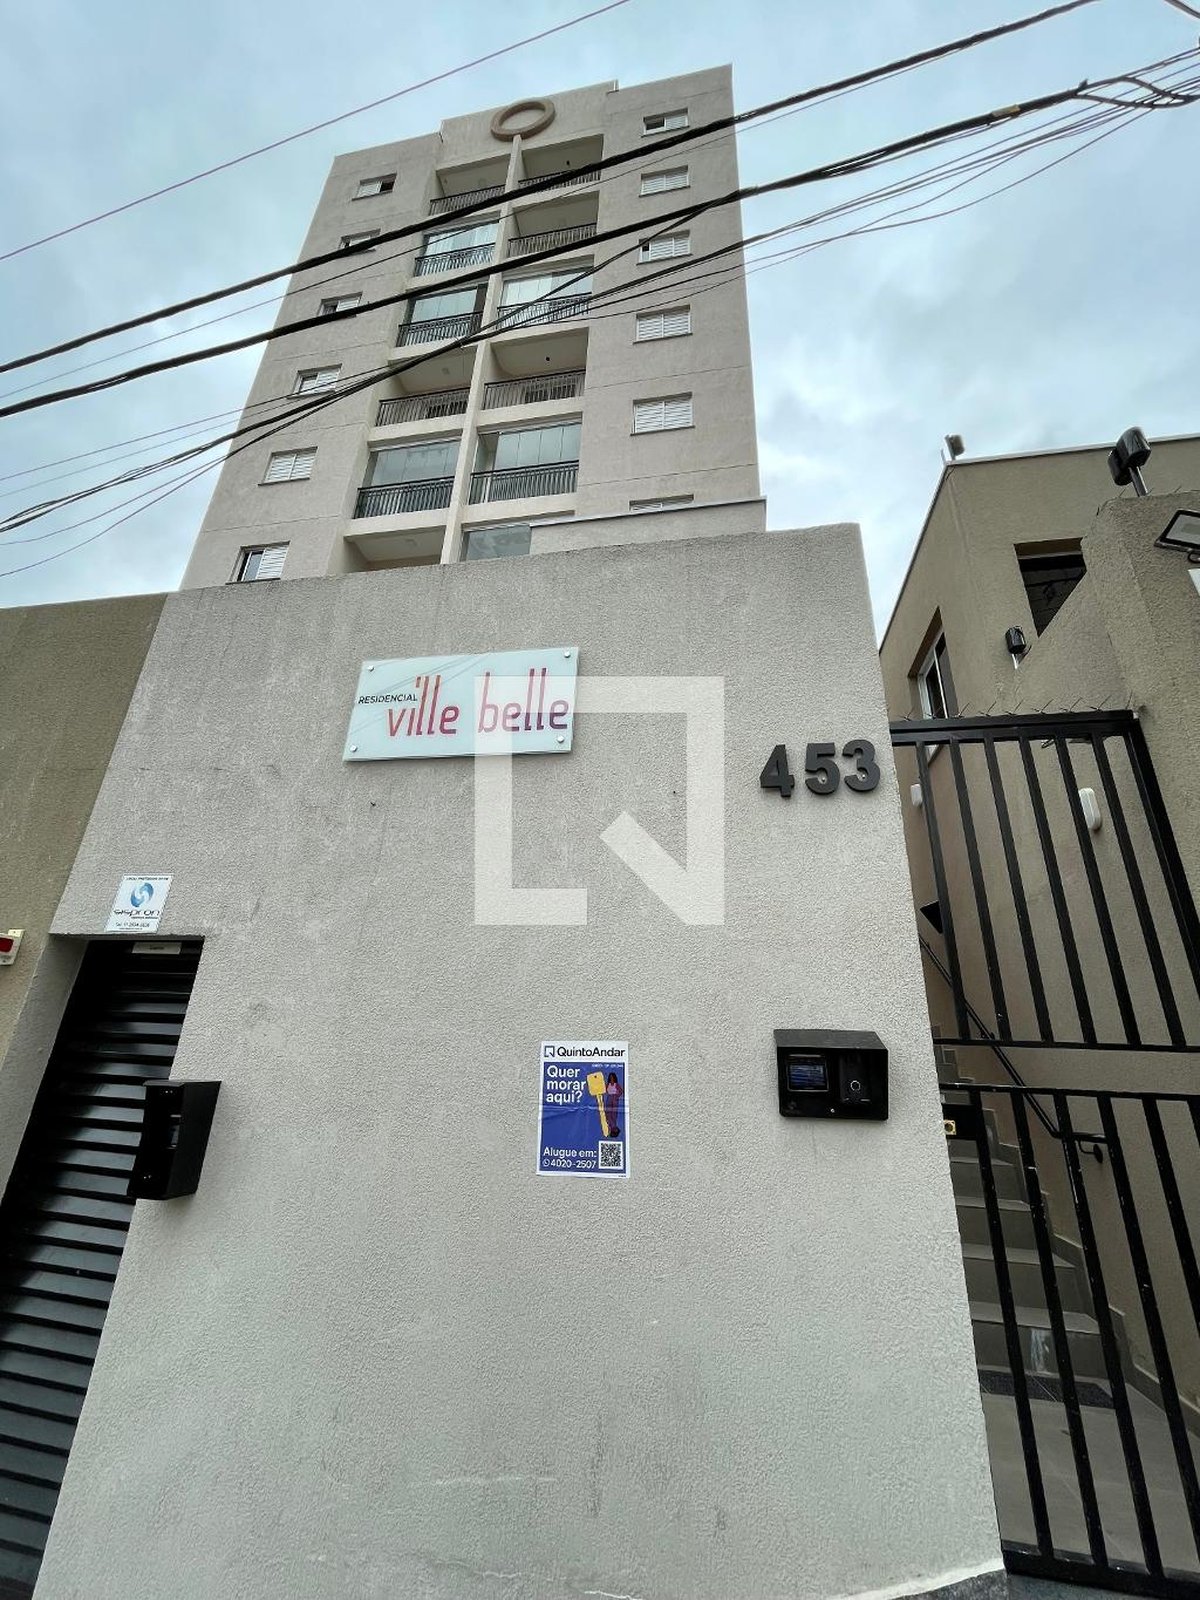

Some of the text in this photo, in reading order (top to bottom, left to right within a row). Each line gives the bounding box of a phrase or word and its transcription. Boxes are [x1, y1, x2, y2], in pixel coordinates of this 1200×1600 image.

[358, 693, 418, 704] RESIDENCIAL
[388, 667, 569, 737] ville belle
[760, 739, 880, 797] 453
[557, 1047, 625, 1057] QuintoAndar
[547, 1065, 580, 1078] Quer
[546, 1079, 586, 1090] morar
[546, 1091, 582, 1105] aqui?
[543, 1147, 597, 1158] Alugue em:
[550, 1158, 596, 1169] 4020-2507
